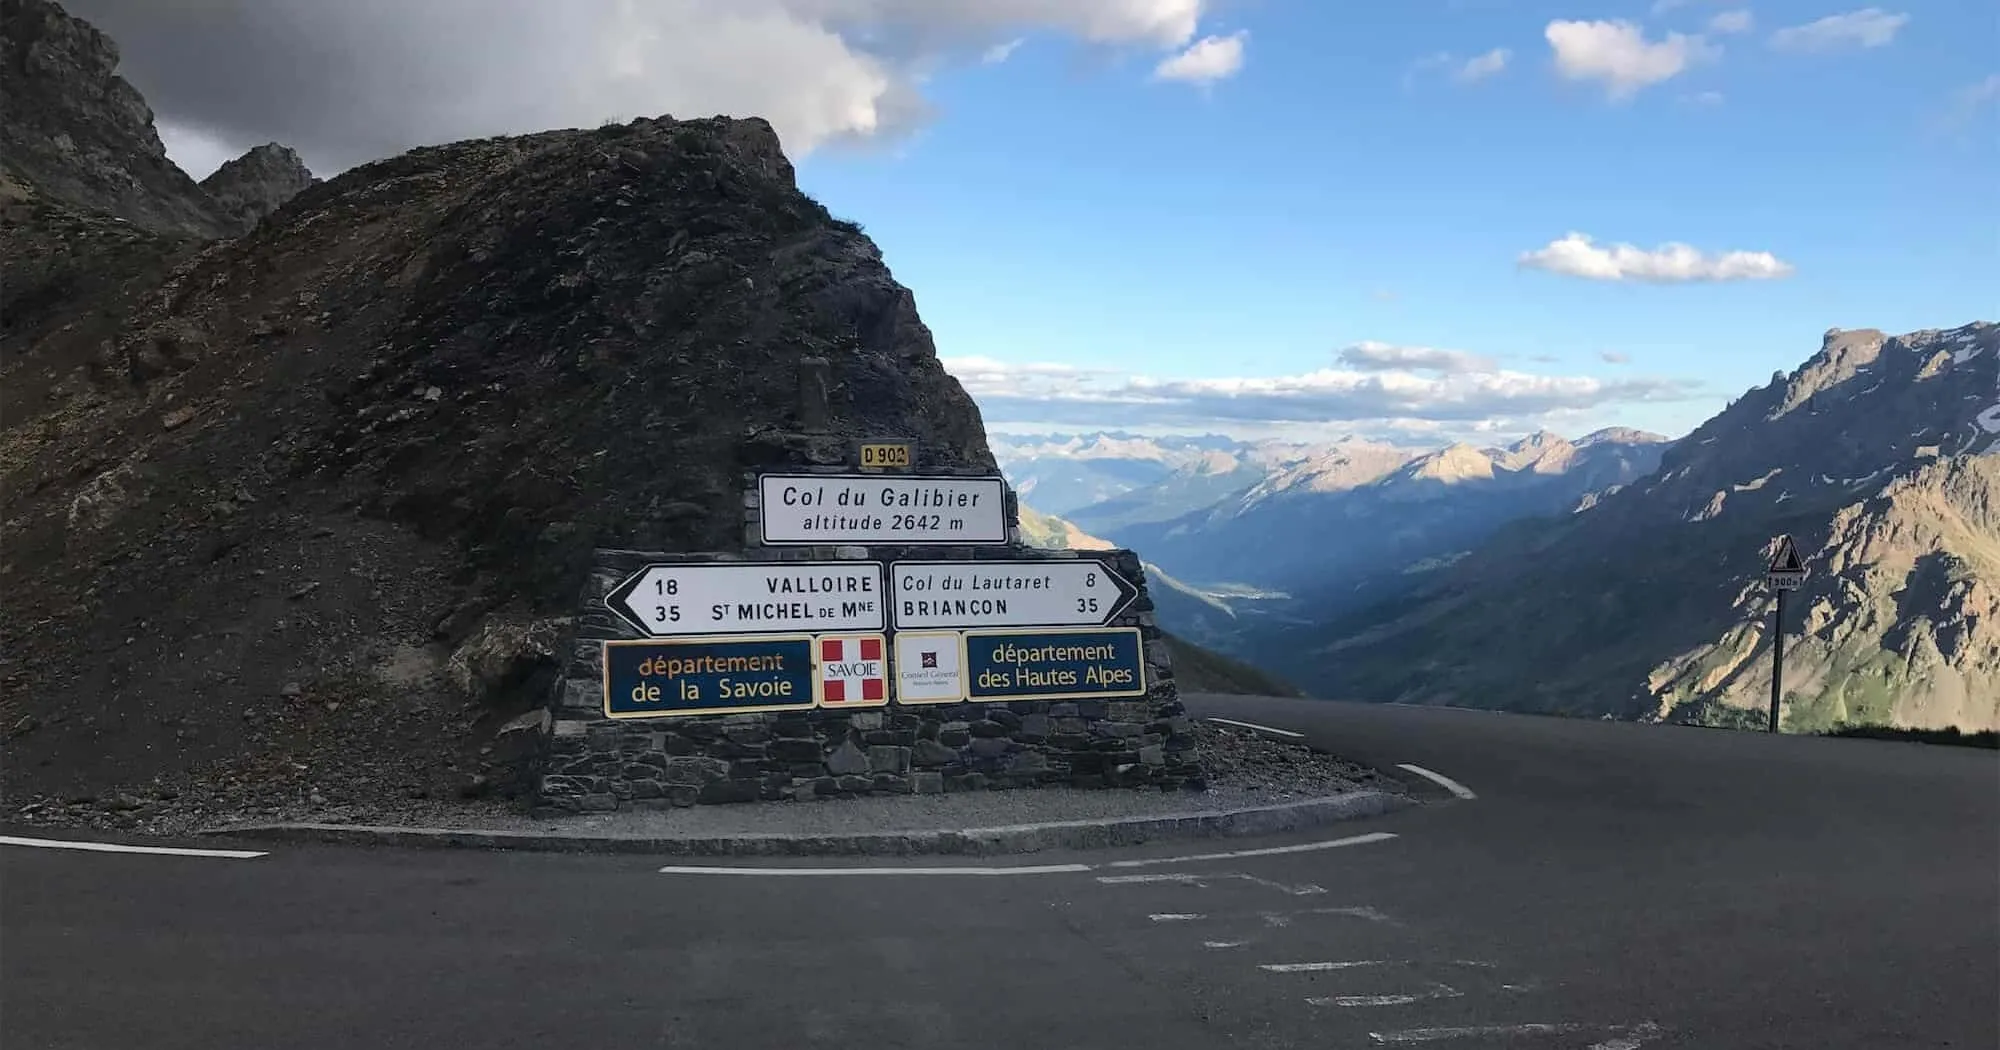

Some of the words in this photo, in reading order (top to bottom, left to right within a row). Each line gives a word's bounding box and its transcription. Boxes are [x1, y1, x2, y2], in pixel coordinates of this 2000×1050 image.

[865, 448, 873, 462] D
[879, 448, 904, 462] 902
[783, 487, 823, 506] Col
[838, 488, 865, 506] du
[881, 488, 980, 507] Galibier
[803, 514, 882, 530] altitude
[891, 515, 941, 530] 2642
[950, 519, 963, 530] m
[655, 579, 678, 595] 18
[767, 577, 872, 593] VALLOIRE
[903, 575, 932, 591] Col
[942, 575, 963, 590] du
[972, 575, 1051, 590] Lautaret
[1086, 573, 1096, 587] 8
[655, 606, 681, 622] 35
[738, 602, 813, 620] MICHEL
[819, 607, 835, 618] DE
[904, 599, 1007, 616] BRIANÇON
[1077, 598, 1098, 613] 35
[992, 643, 1116, 666] département
[639, 652, 784, 679] département
[828, 662, 877, 677] SAVOIE
[978, 668, 1010, 688] des
[1016, 667, 1076, 687] Hautes
[1086, 664, 1133, 688] Alpes
[631, 681, 661, 702] de
[680, 679, 700, 700] la
[719, 676, 793, 699] Savoie
